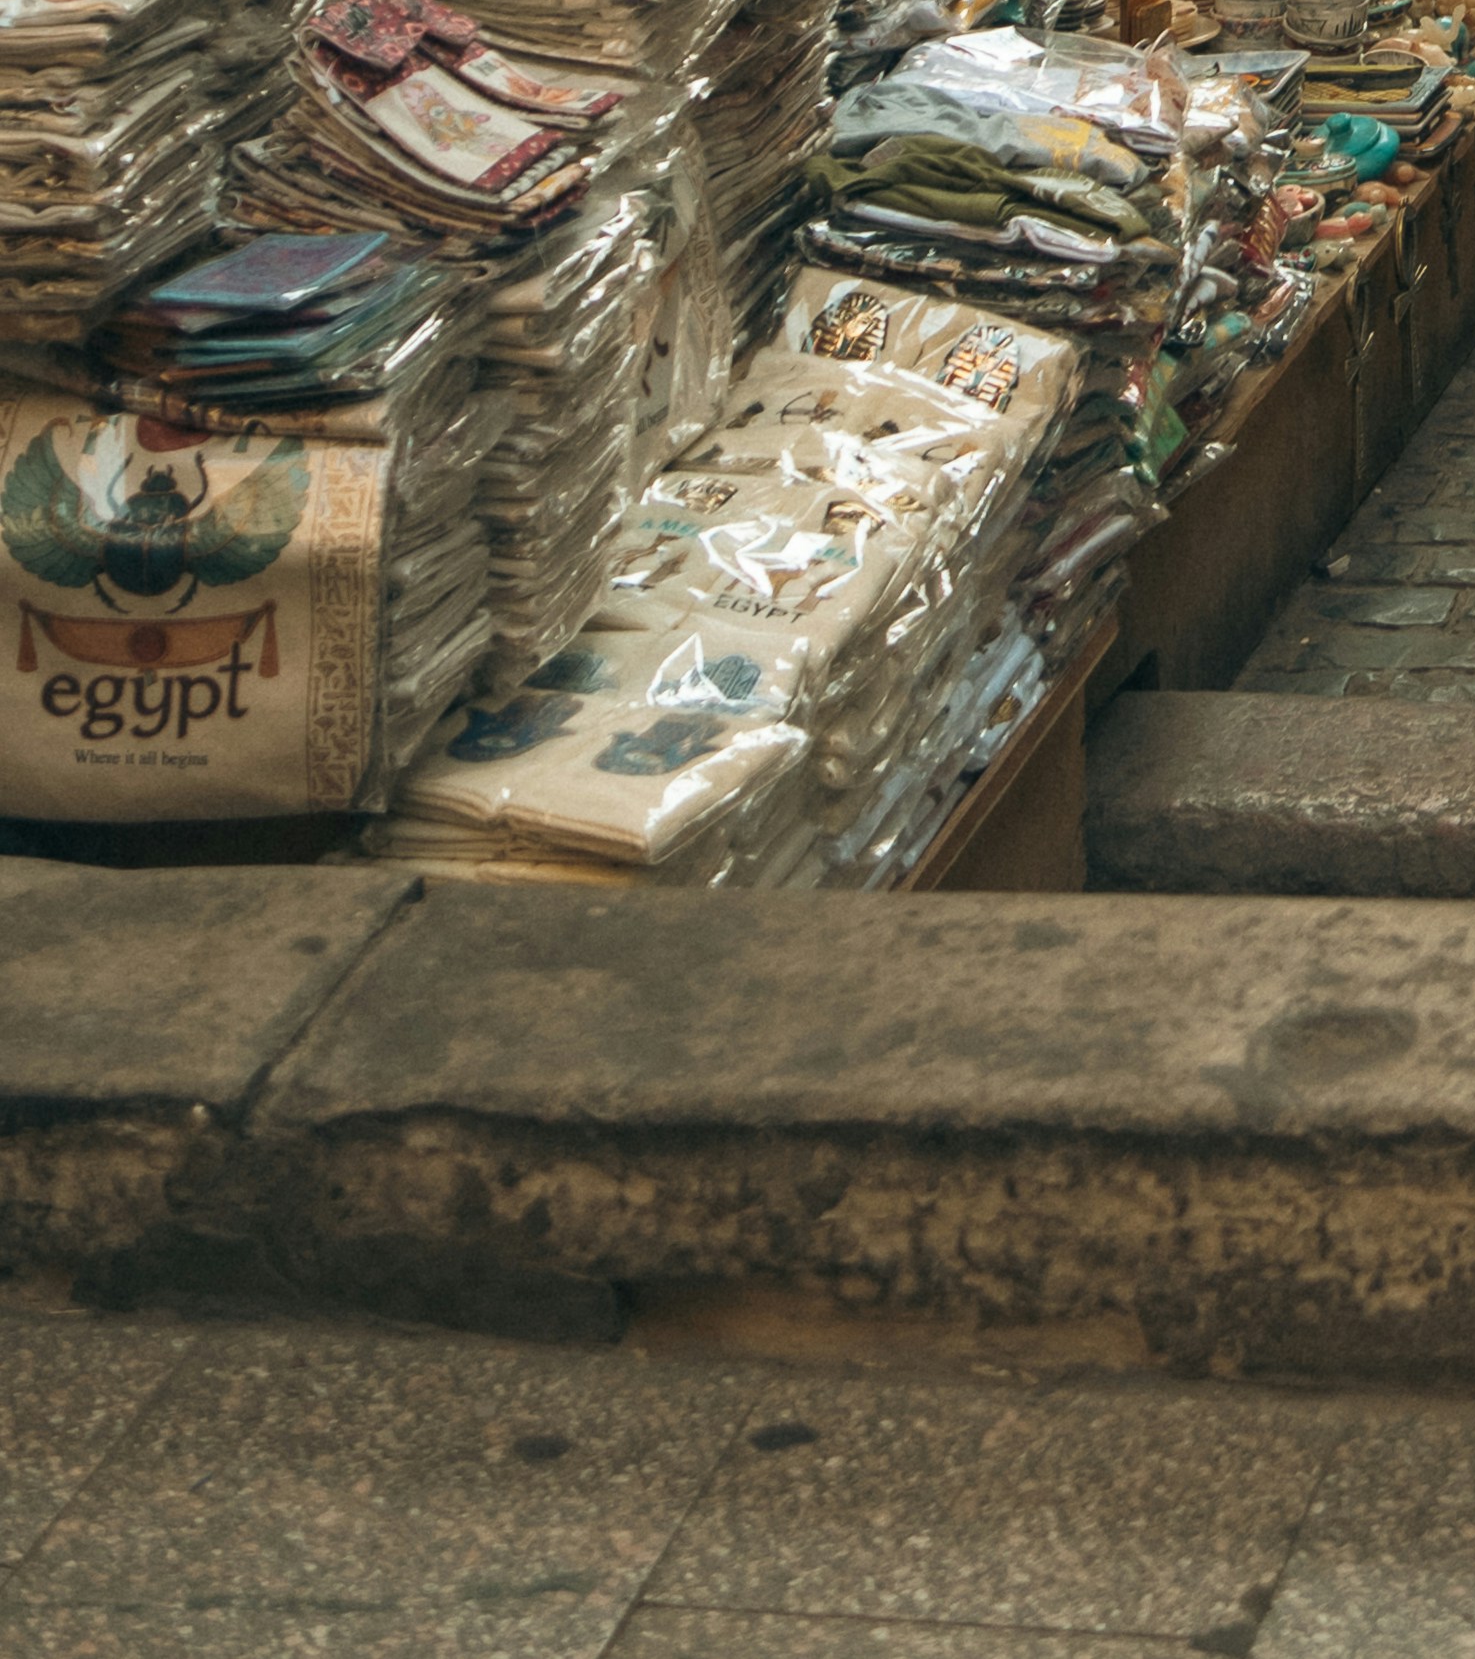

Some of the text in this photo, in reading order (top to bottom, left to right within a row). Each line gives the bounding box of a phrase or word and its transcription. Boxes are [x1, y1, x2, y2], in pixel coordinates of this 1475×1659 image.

[712, 593, 808, 624] EGYPT
[41, 641, 254, 740] egypt
[74, 749, 209, 769] Where it all begins
